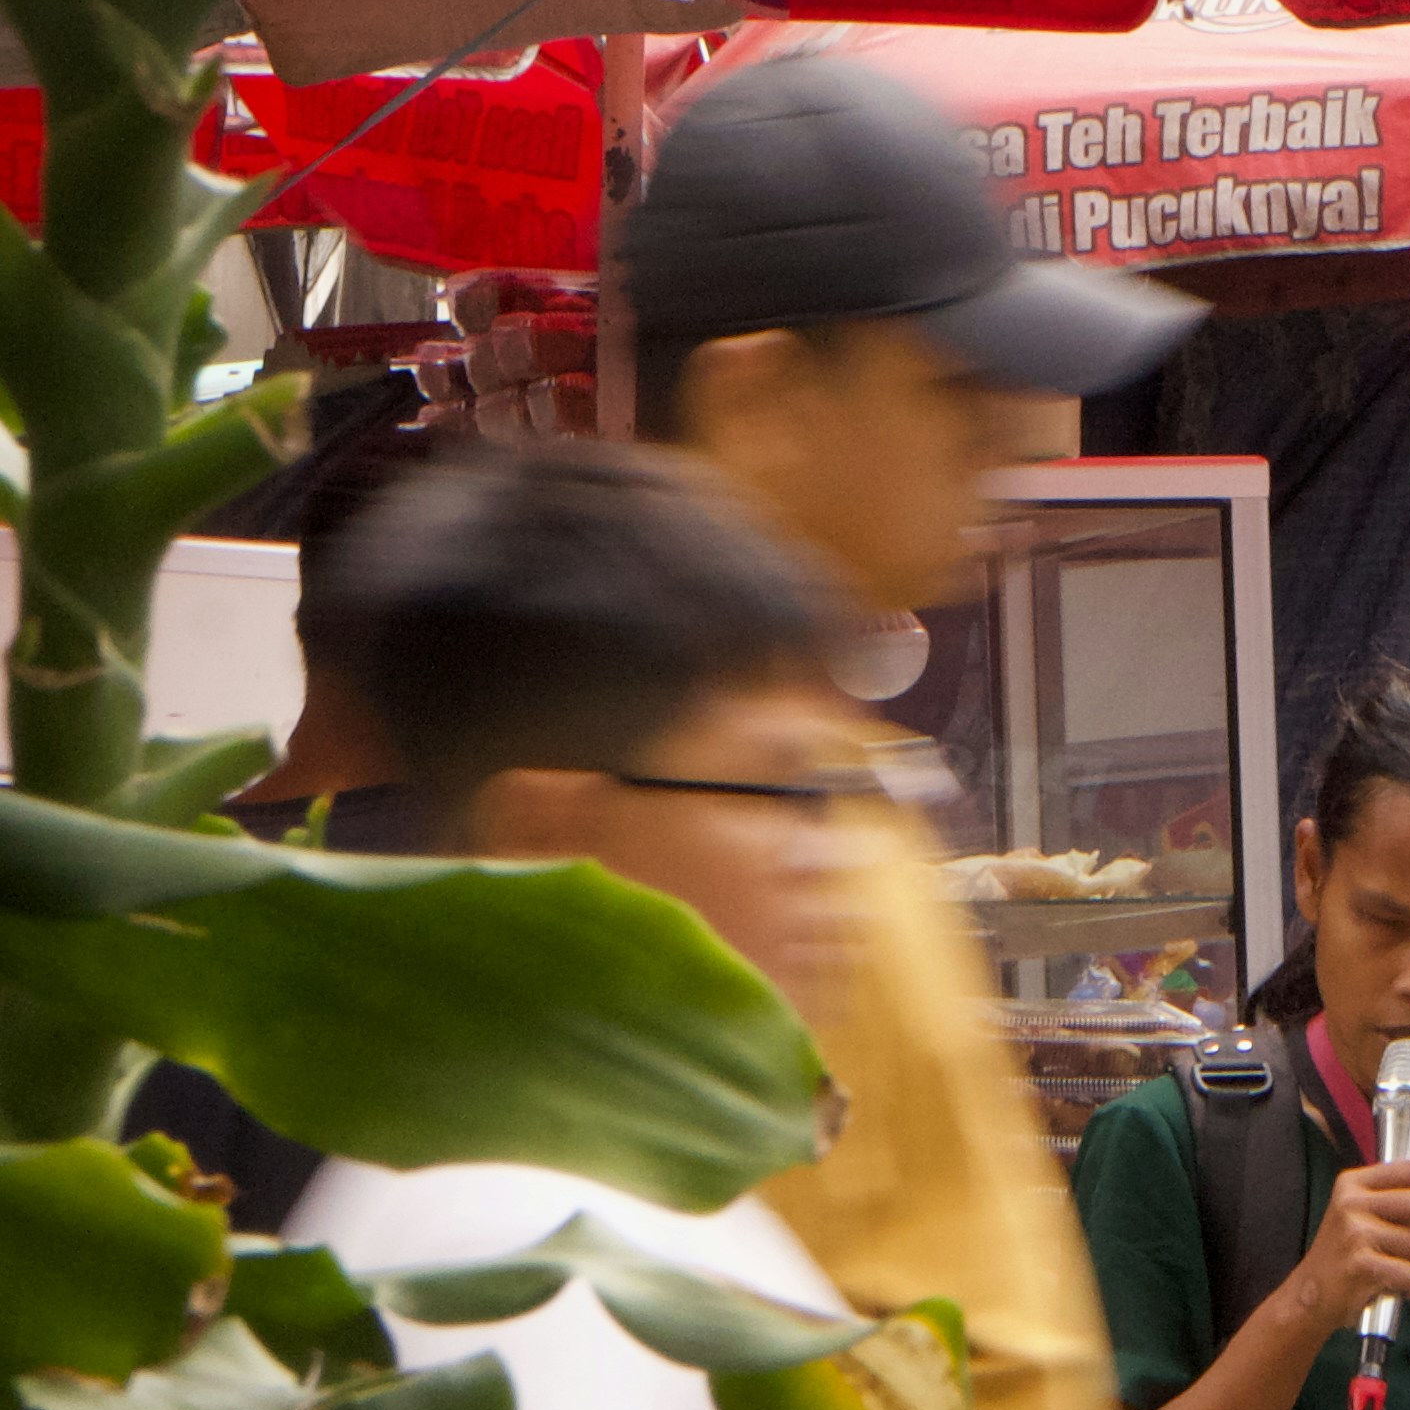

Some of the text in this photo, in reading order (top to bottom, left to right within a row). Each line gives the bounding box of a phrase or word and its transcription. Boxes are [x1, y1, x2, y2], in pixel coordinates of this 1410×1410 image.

[1038, 106, 1143, 172] Teh
[1154, 88, 1380, 161] Terbaik
[1009, 170, 1381, 253] di Pucuknya!
